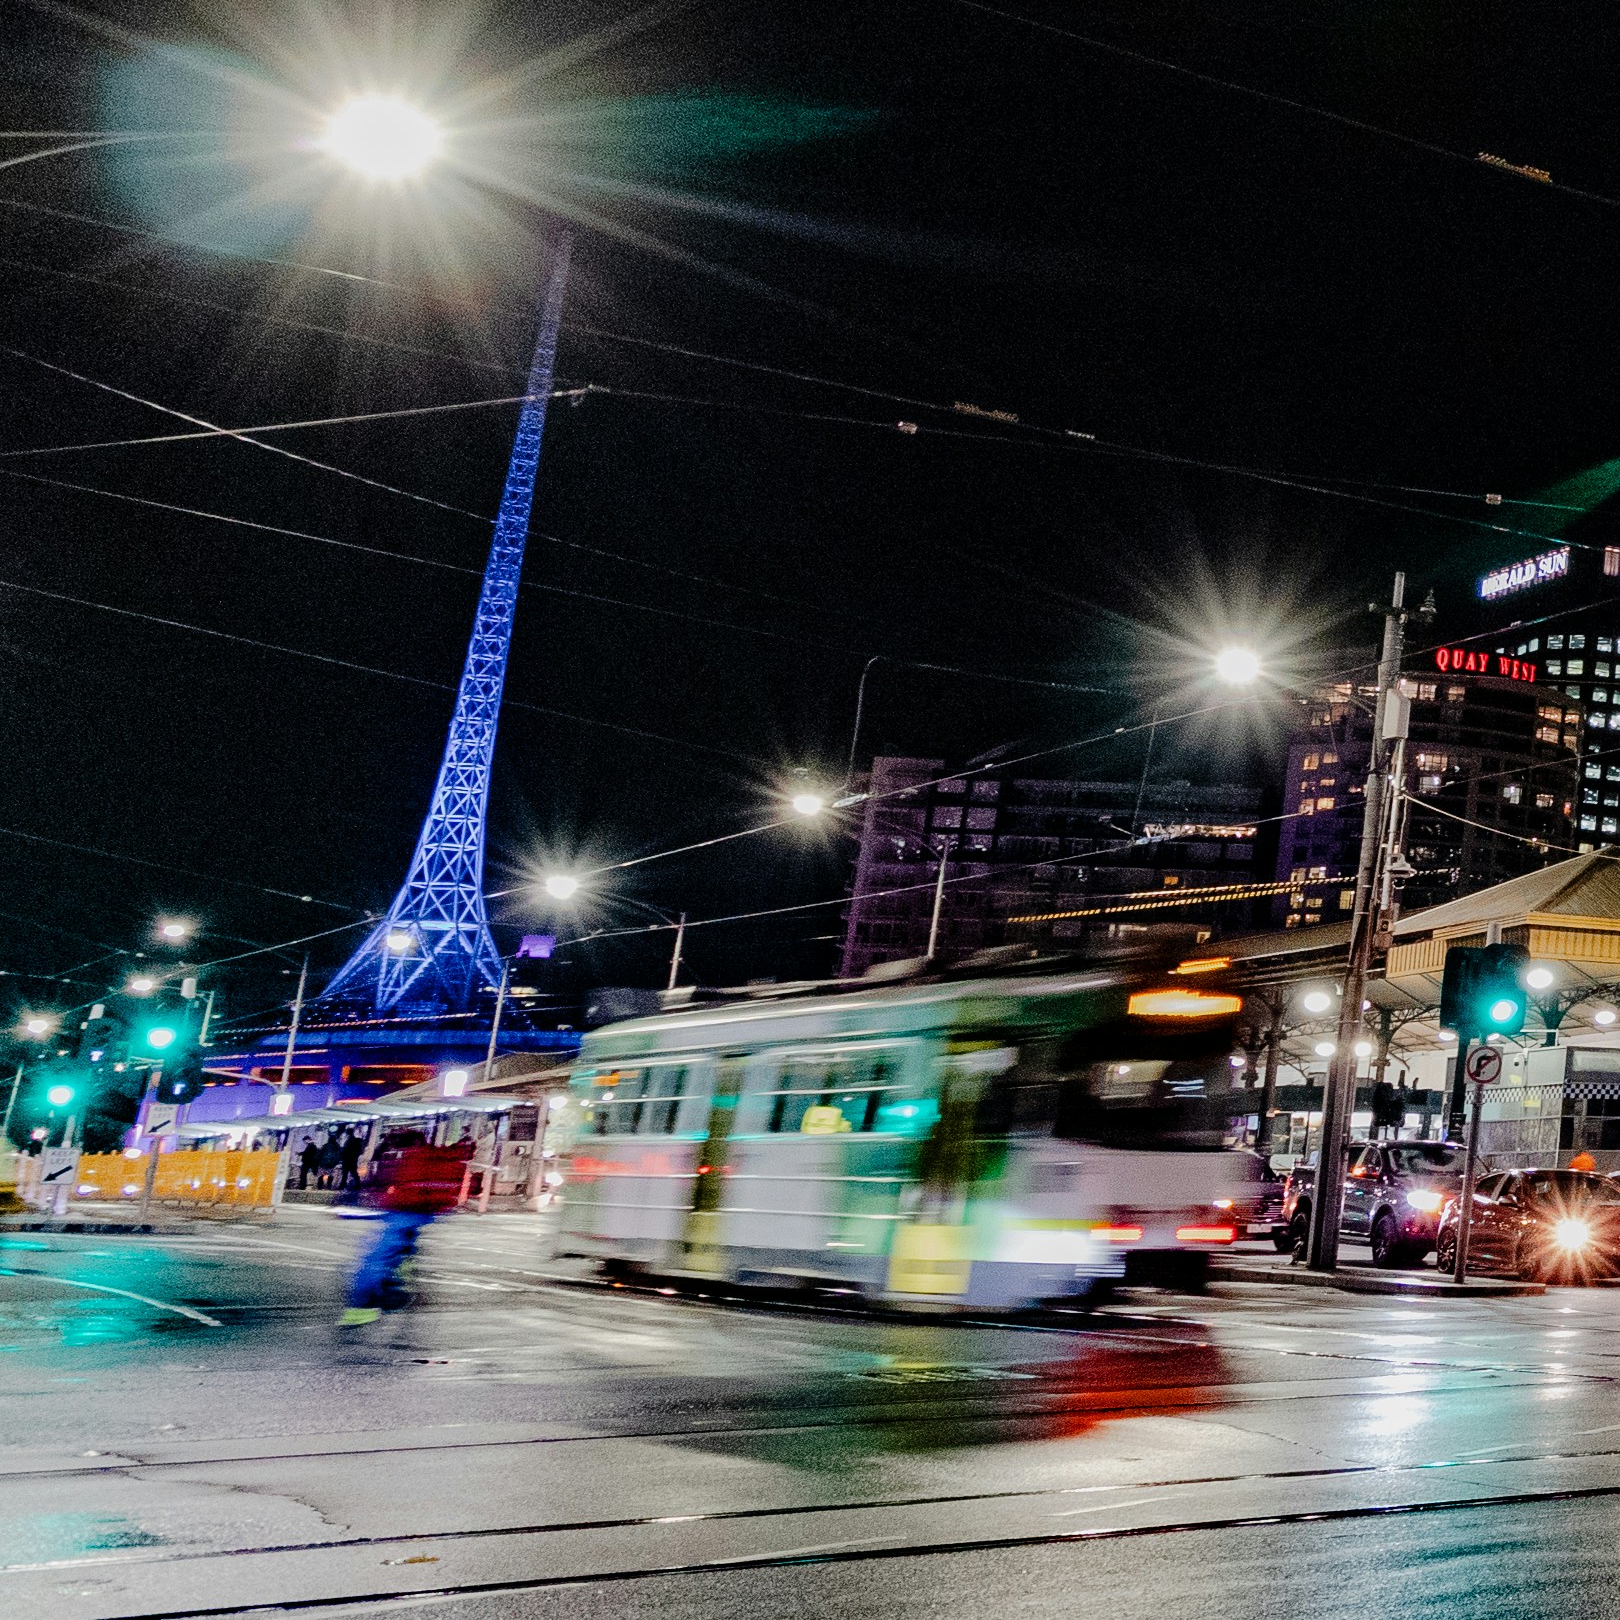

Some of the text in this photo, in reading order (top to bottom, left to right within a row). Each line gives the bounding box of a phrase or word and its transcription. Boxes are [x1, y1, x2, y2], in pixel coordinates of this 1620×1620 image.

[1539, 552, 1567, 577] SUN
[1436, 647, 1537, 683] QUAY WEST
